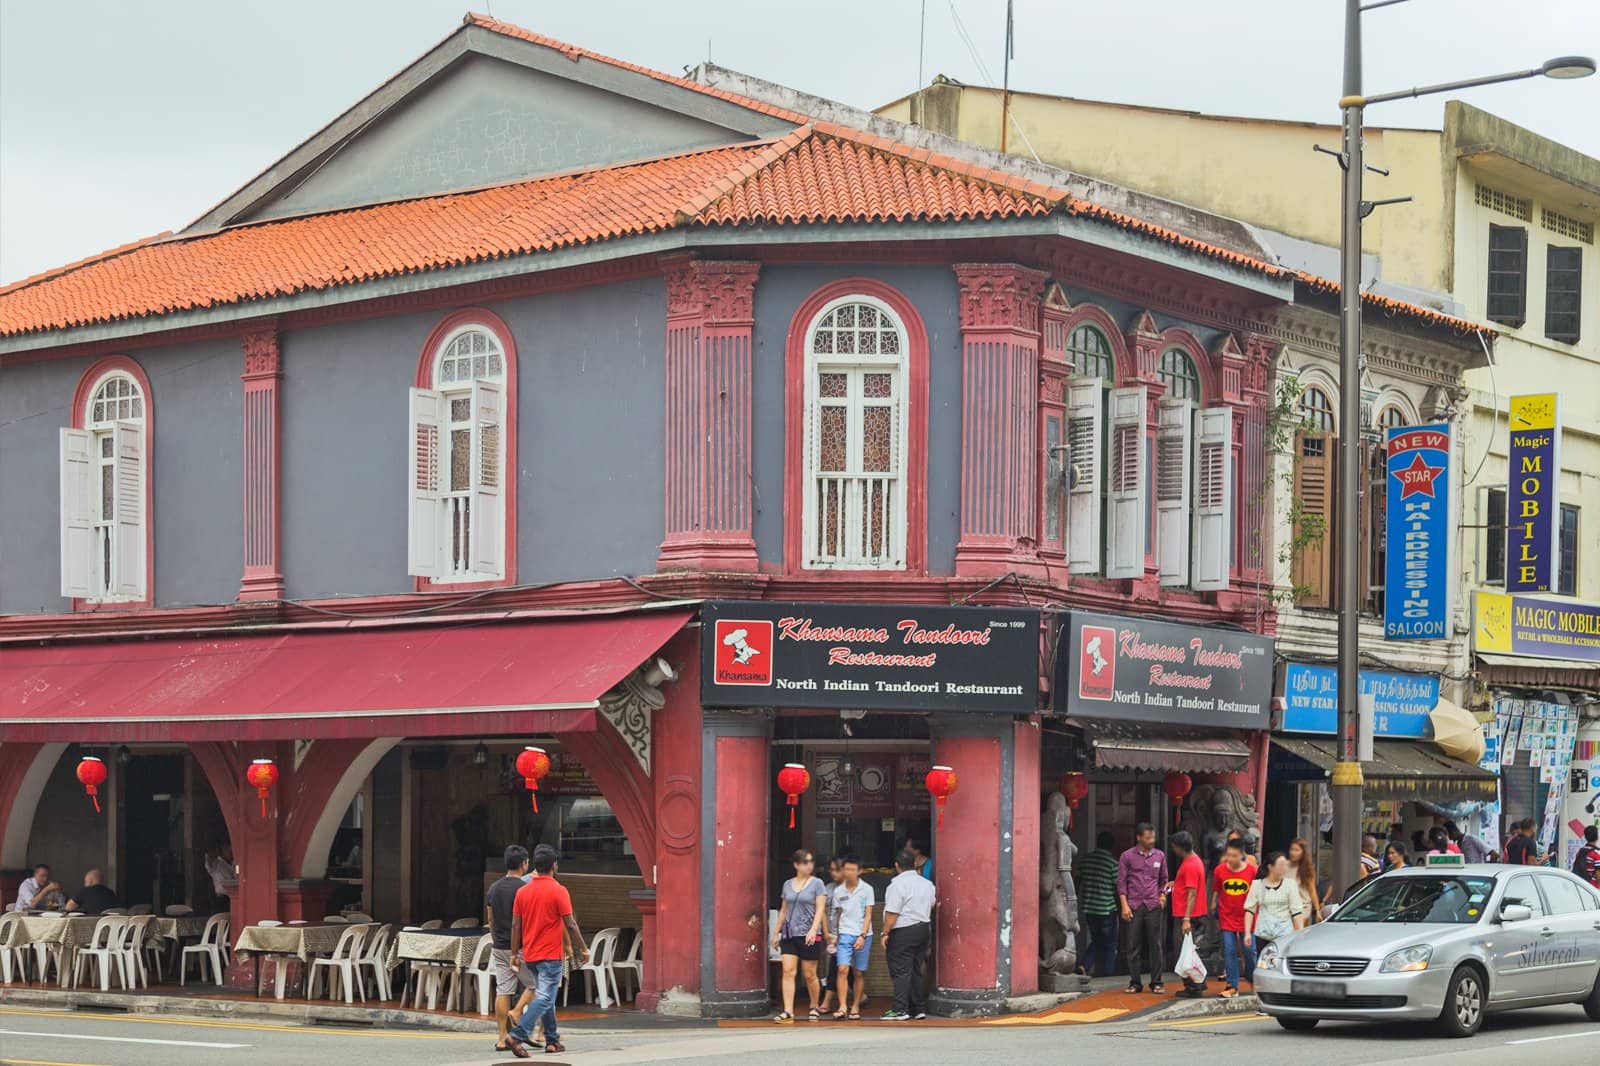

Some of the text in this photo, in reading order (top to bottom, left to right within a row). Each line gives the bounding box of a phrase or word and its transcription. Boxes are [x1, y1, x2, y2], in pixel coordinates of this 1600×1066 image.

[1395, 434, 1443, 450] NEW
[1514, 434, 1550, 448] Magic
[1404, 470, 1431, 484] STAR
[1518, 455, 1542, 584] MOBILE
[1403, 502, 1431, 618] HAIRDRESSING
[1387, 620, 1444, 637] SALOON
[1515, 606, 1556, 630] MAGIC
[777, 617, 991, 646] Khansama Tandoori
[829, 647, 937, 668] Restaurant
[1119, 630, 1243, 670] Khansama Tandoori
[719, 669, 768, 681] Khansama
[1149, 664, 1212, 690] Restaurant
[776, 678, 1023, 696] North Indian Tandoori Restaurant
[1114, 690, 1141, 705] North
[1144, 692, 1173, 707] Indian
[1176, 695, 1214, 710] Tandoori
[1218, 699, 1260, 714] Restaurant
[1291, 695, 1310, 708] NEW
[1312, 697, 1333, 709] STAR
[1400, 703, 1430, 715] SALOON
[1519, 937, 1580, 967] Silvercab
